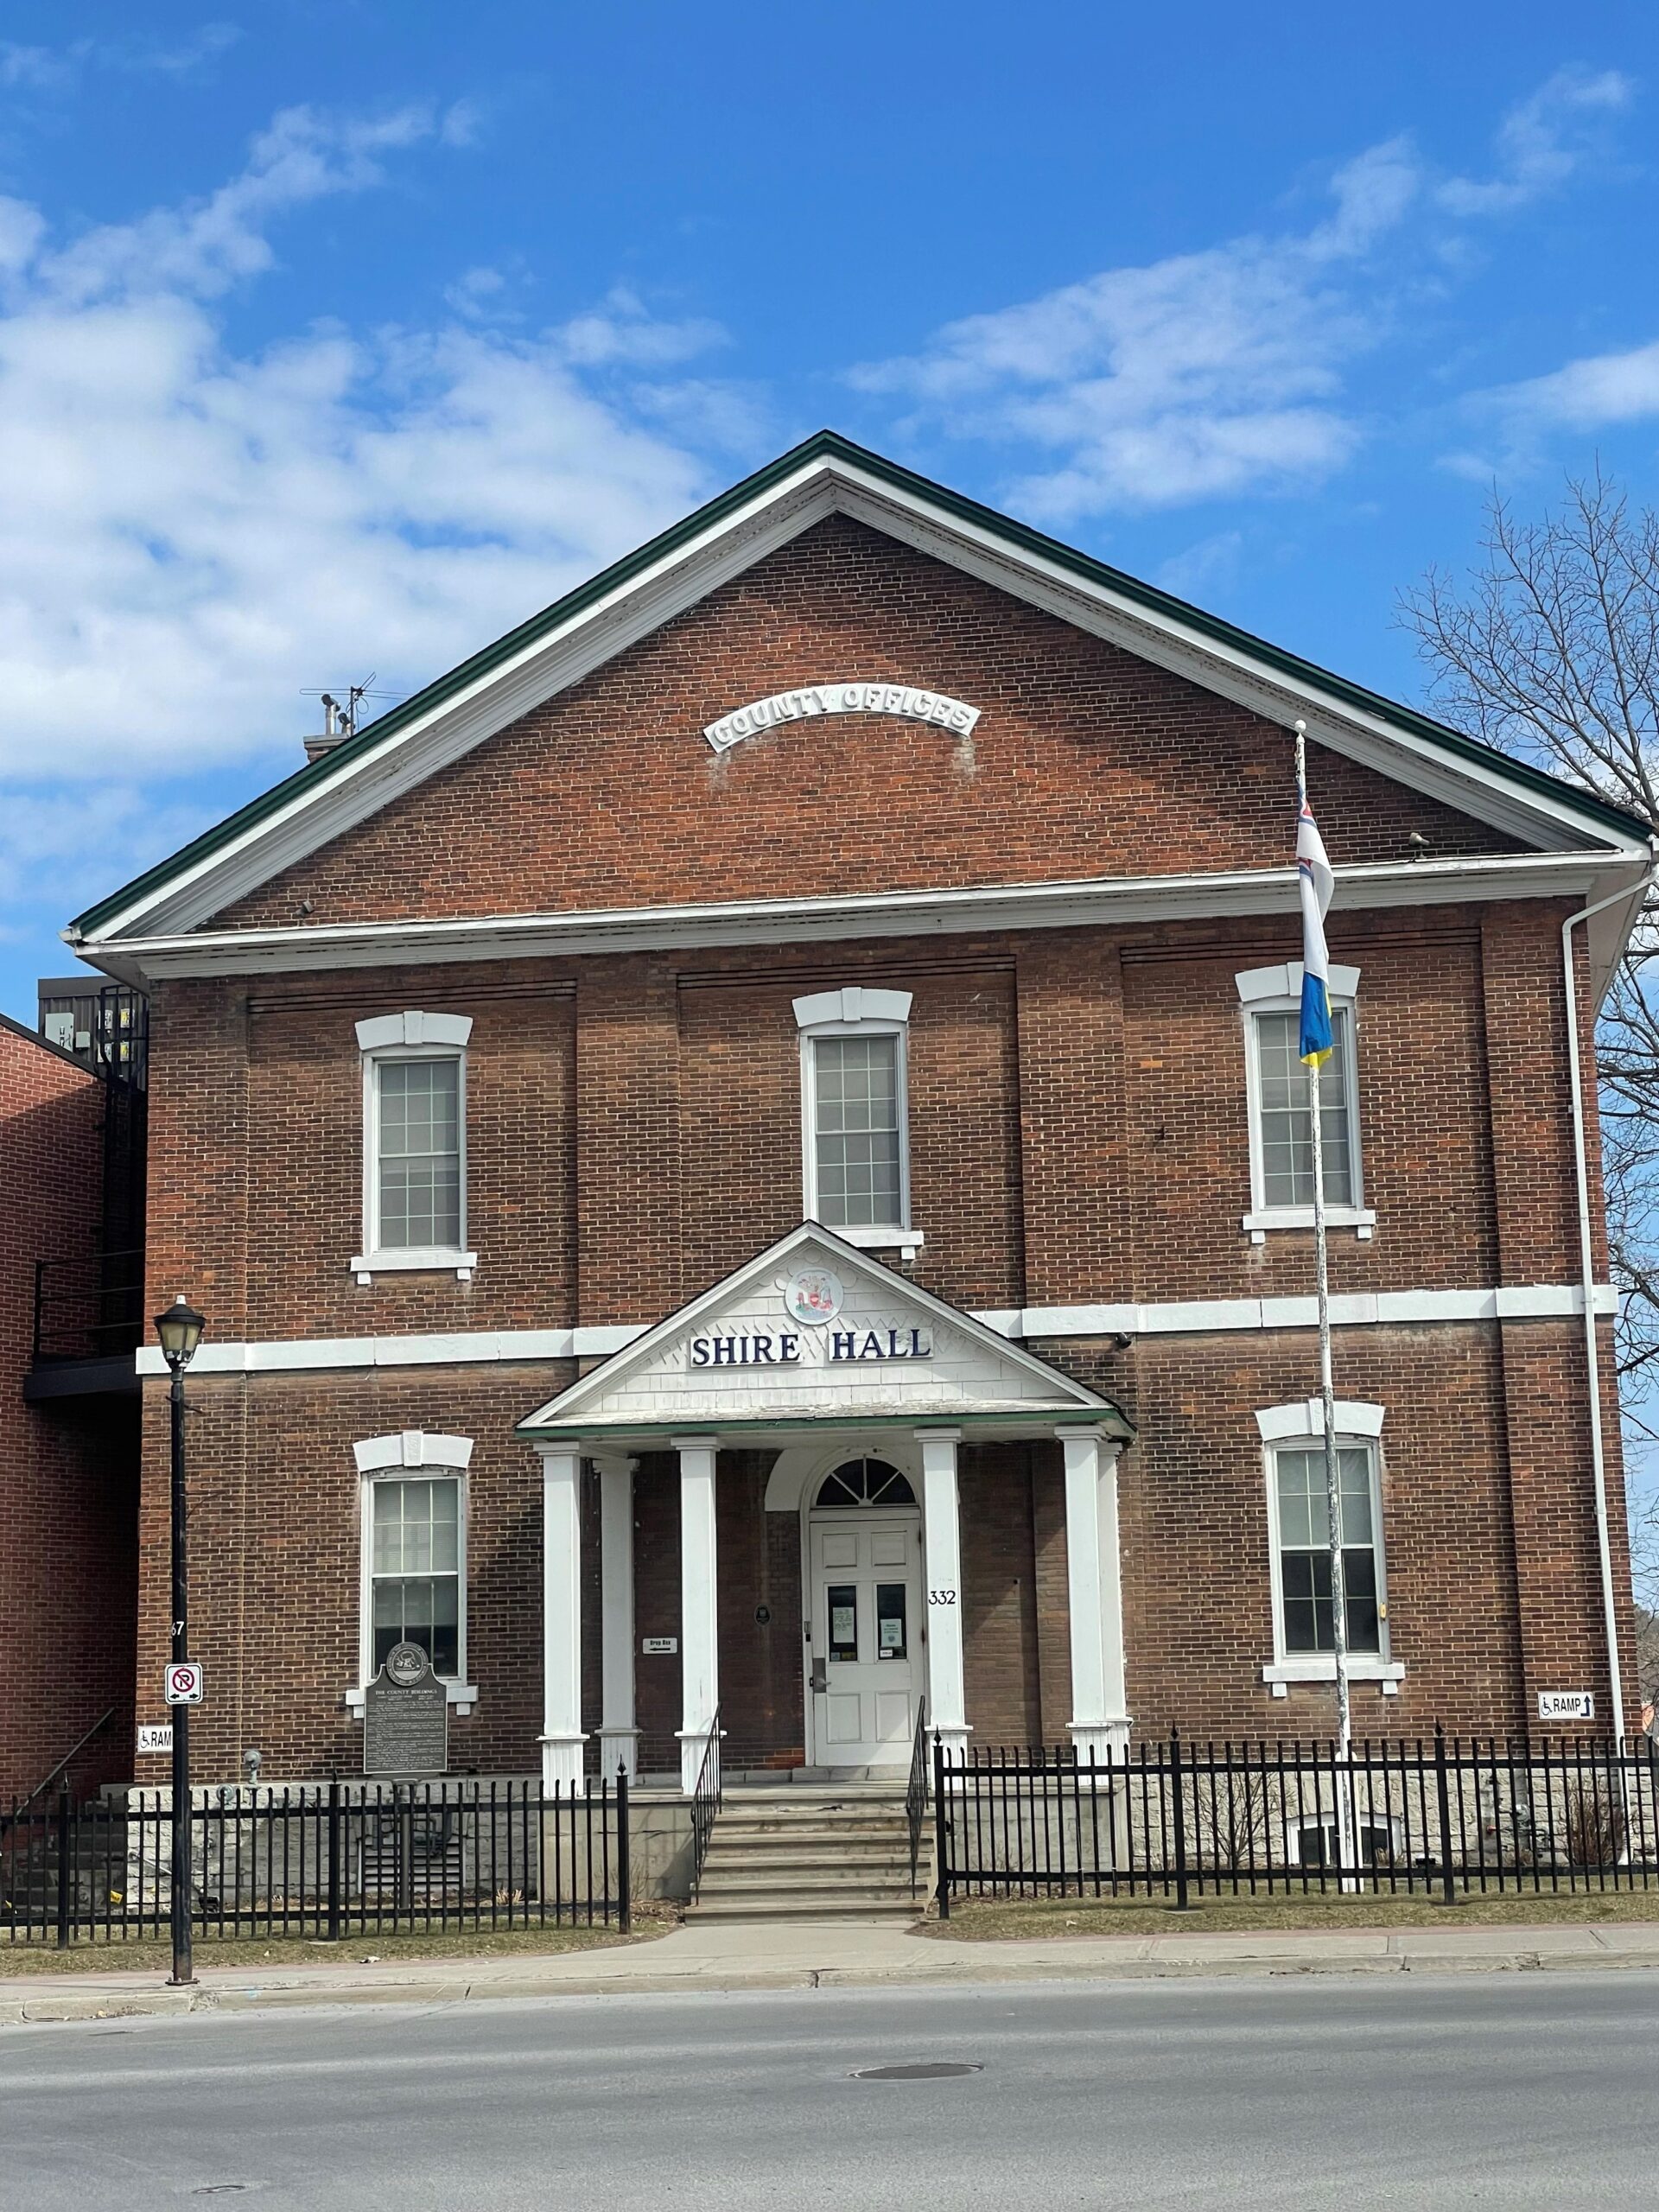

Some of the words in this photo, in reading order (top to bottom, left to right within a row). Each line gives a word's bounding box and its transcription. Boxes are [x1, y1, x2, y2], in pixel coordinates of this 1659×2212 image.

[713, 689, 830, 744] COUNTY
[843, 685, 973, 729] OFFICES
[692, 1333, 800, 1365] SHIRE
[832, 1328, 931, 1359] HALL
[928, 1590, 957, 1605] 332
[1553, 1698, 1581, 1712] RAMP
[150, 1731, 172, 1747] RAM
